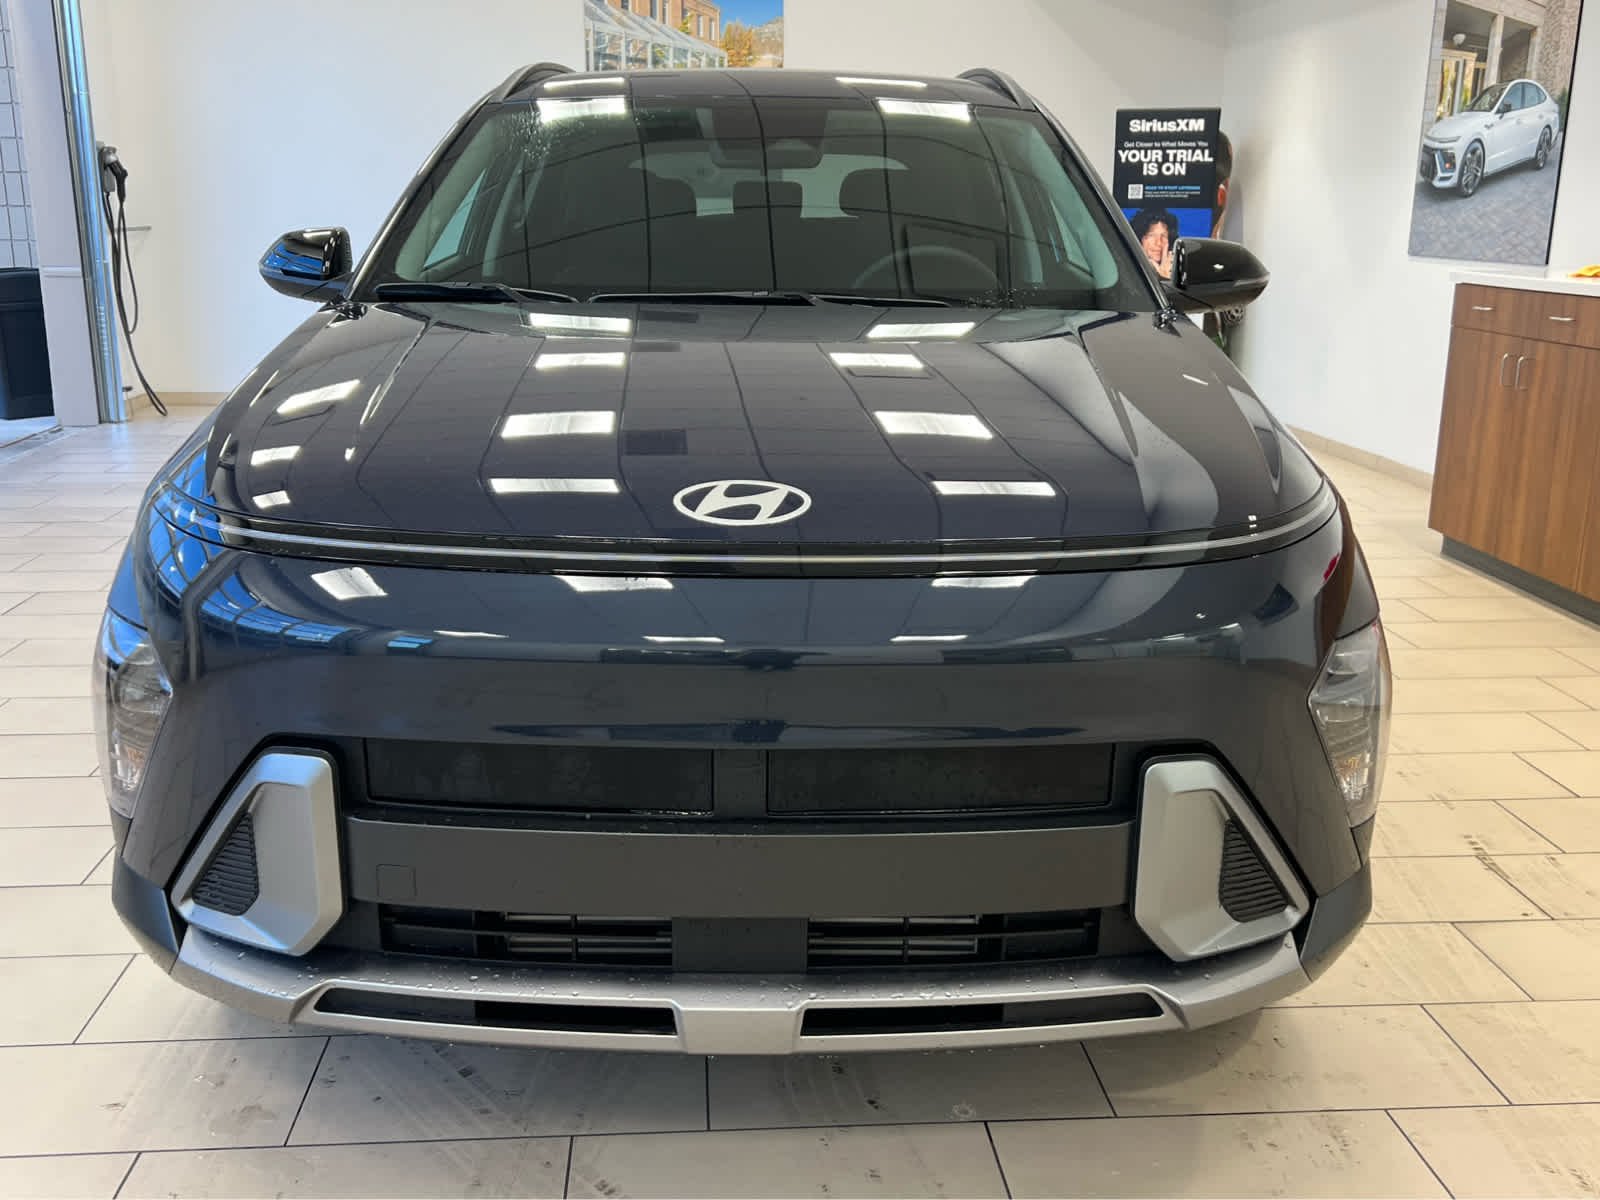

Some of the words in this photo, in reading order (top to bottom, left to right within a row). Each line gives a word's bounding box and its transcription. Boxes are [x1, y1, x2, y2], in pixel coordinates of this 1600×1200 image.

[1129, 118, 1205, 132] SiriusXM
[1118, 149, 1163, 163] YOUR
[1166, 149, 1213, 162] TRIAL
[1142, 162, 1158, 176] IS
[1161, 162, 1187, 176] ON
